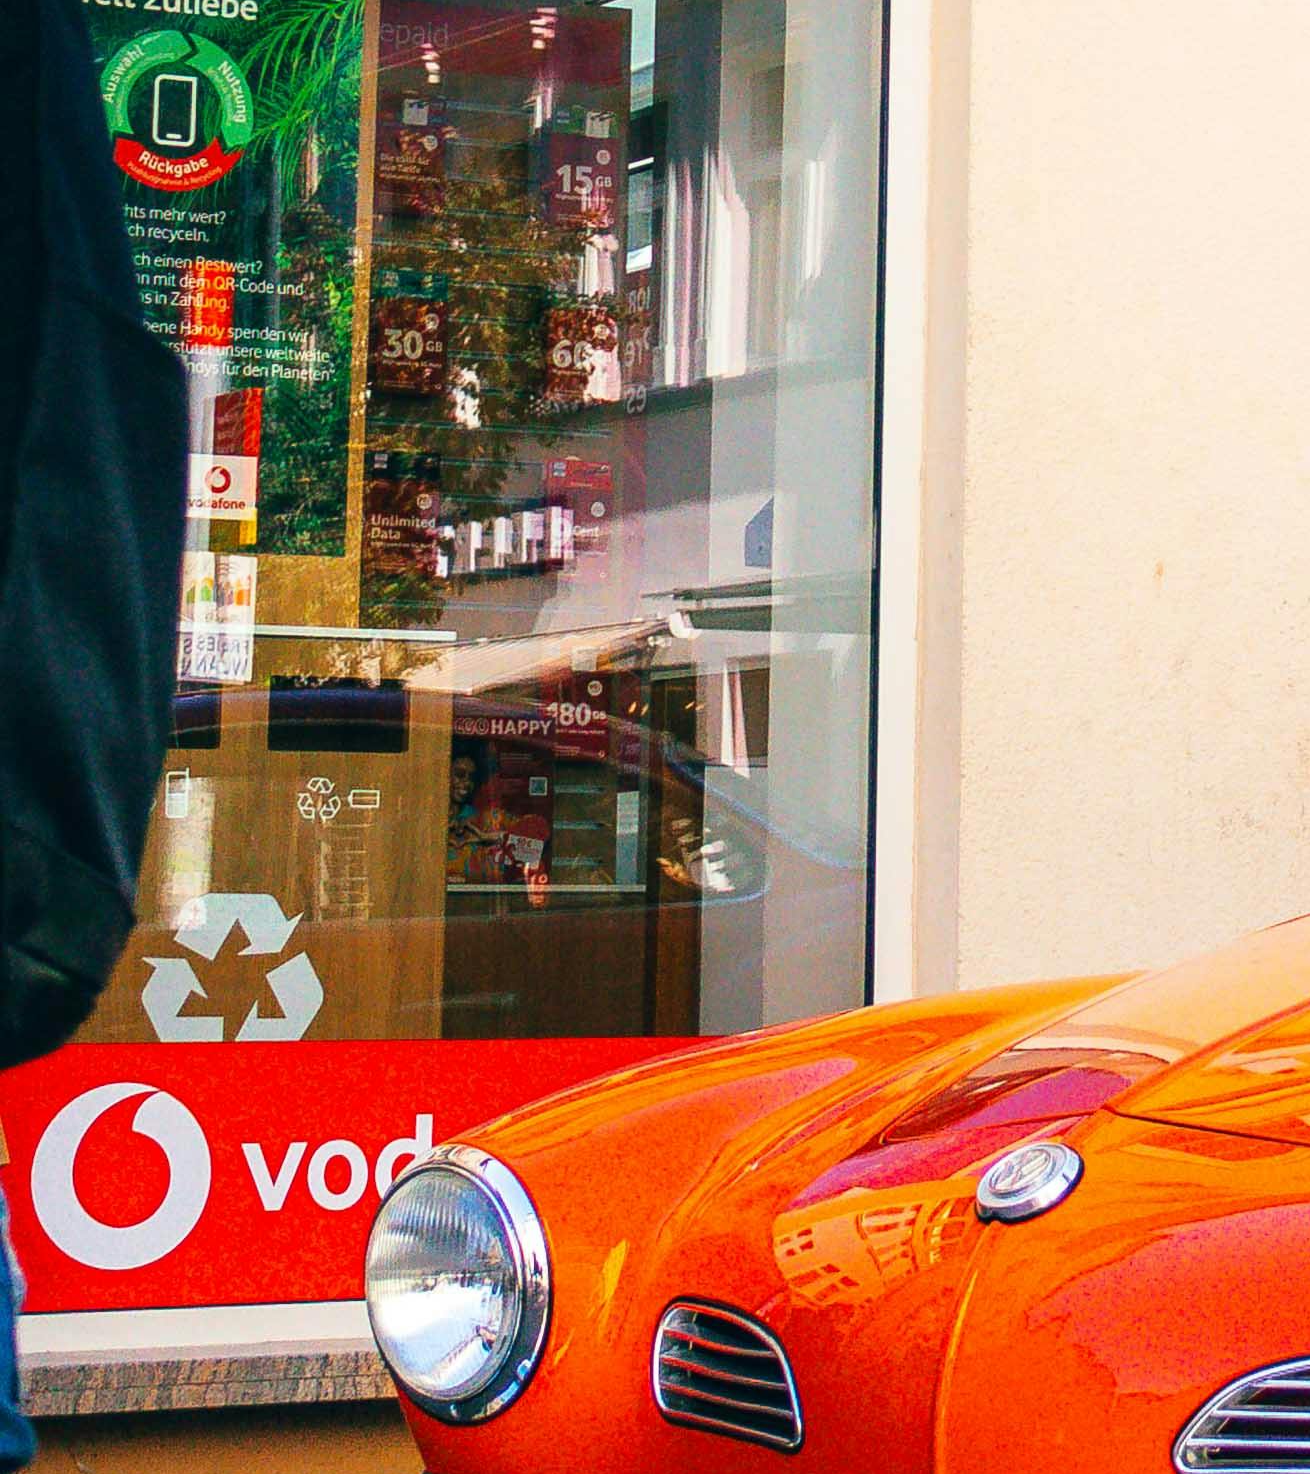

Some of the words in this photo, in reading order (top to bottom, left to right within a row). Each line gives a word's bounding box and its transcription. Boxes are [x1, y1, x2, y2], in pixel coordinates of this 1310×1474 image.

[217, 60, 247, 124] Nutzung
[138, 150, 209, 178] Rückgabe
[556, 164, 593, 195] 15
[594, 175, 613, 188] GB
[149, 207, 186, 223] mehr
[188, 210, 227, 225] wert?
[148, 226, 210, 243] recyceln.
[153, 254, 193, 269] einen
[153, 271, 176, 287] mit
[179, 274, 212, 290] dem
[213, 276, 275, 295] QR-Code
[276, 281, 305, 297] und
[154, 290, 168, 304] in
[170, 291, 230, 313] Zahlung.
[179, 320, 226, 340] Handy
[227, 325, 286, 344] spenden
[381, 328, 424, 360] 30
[425, 340, 443, 353] GB
[242, 362, 268, 377] den
[371, 513, 436, 529] Unlimited
[370, 527, 401, 540] Data
[490, 718, 553, 736] HAPPY
